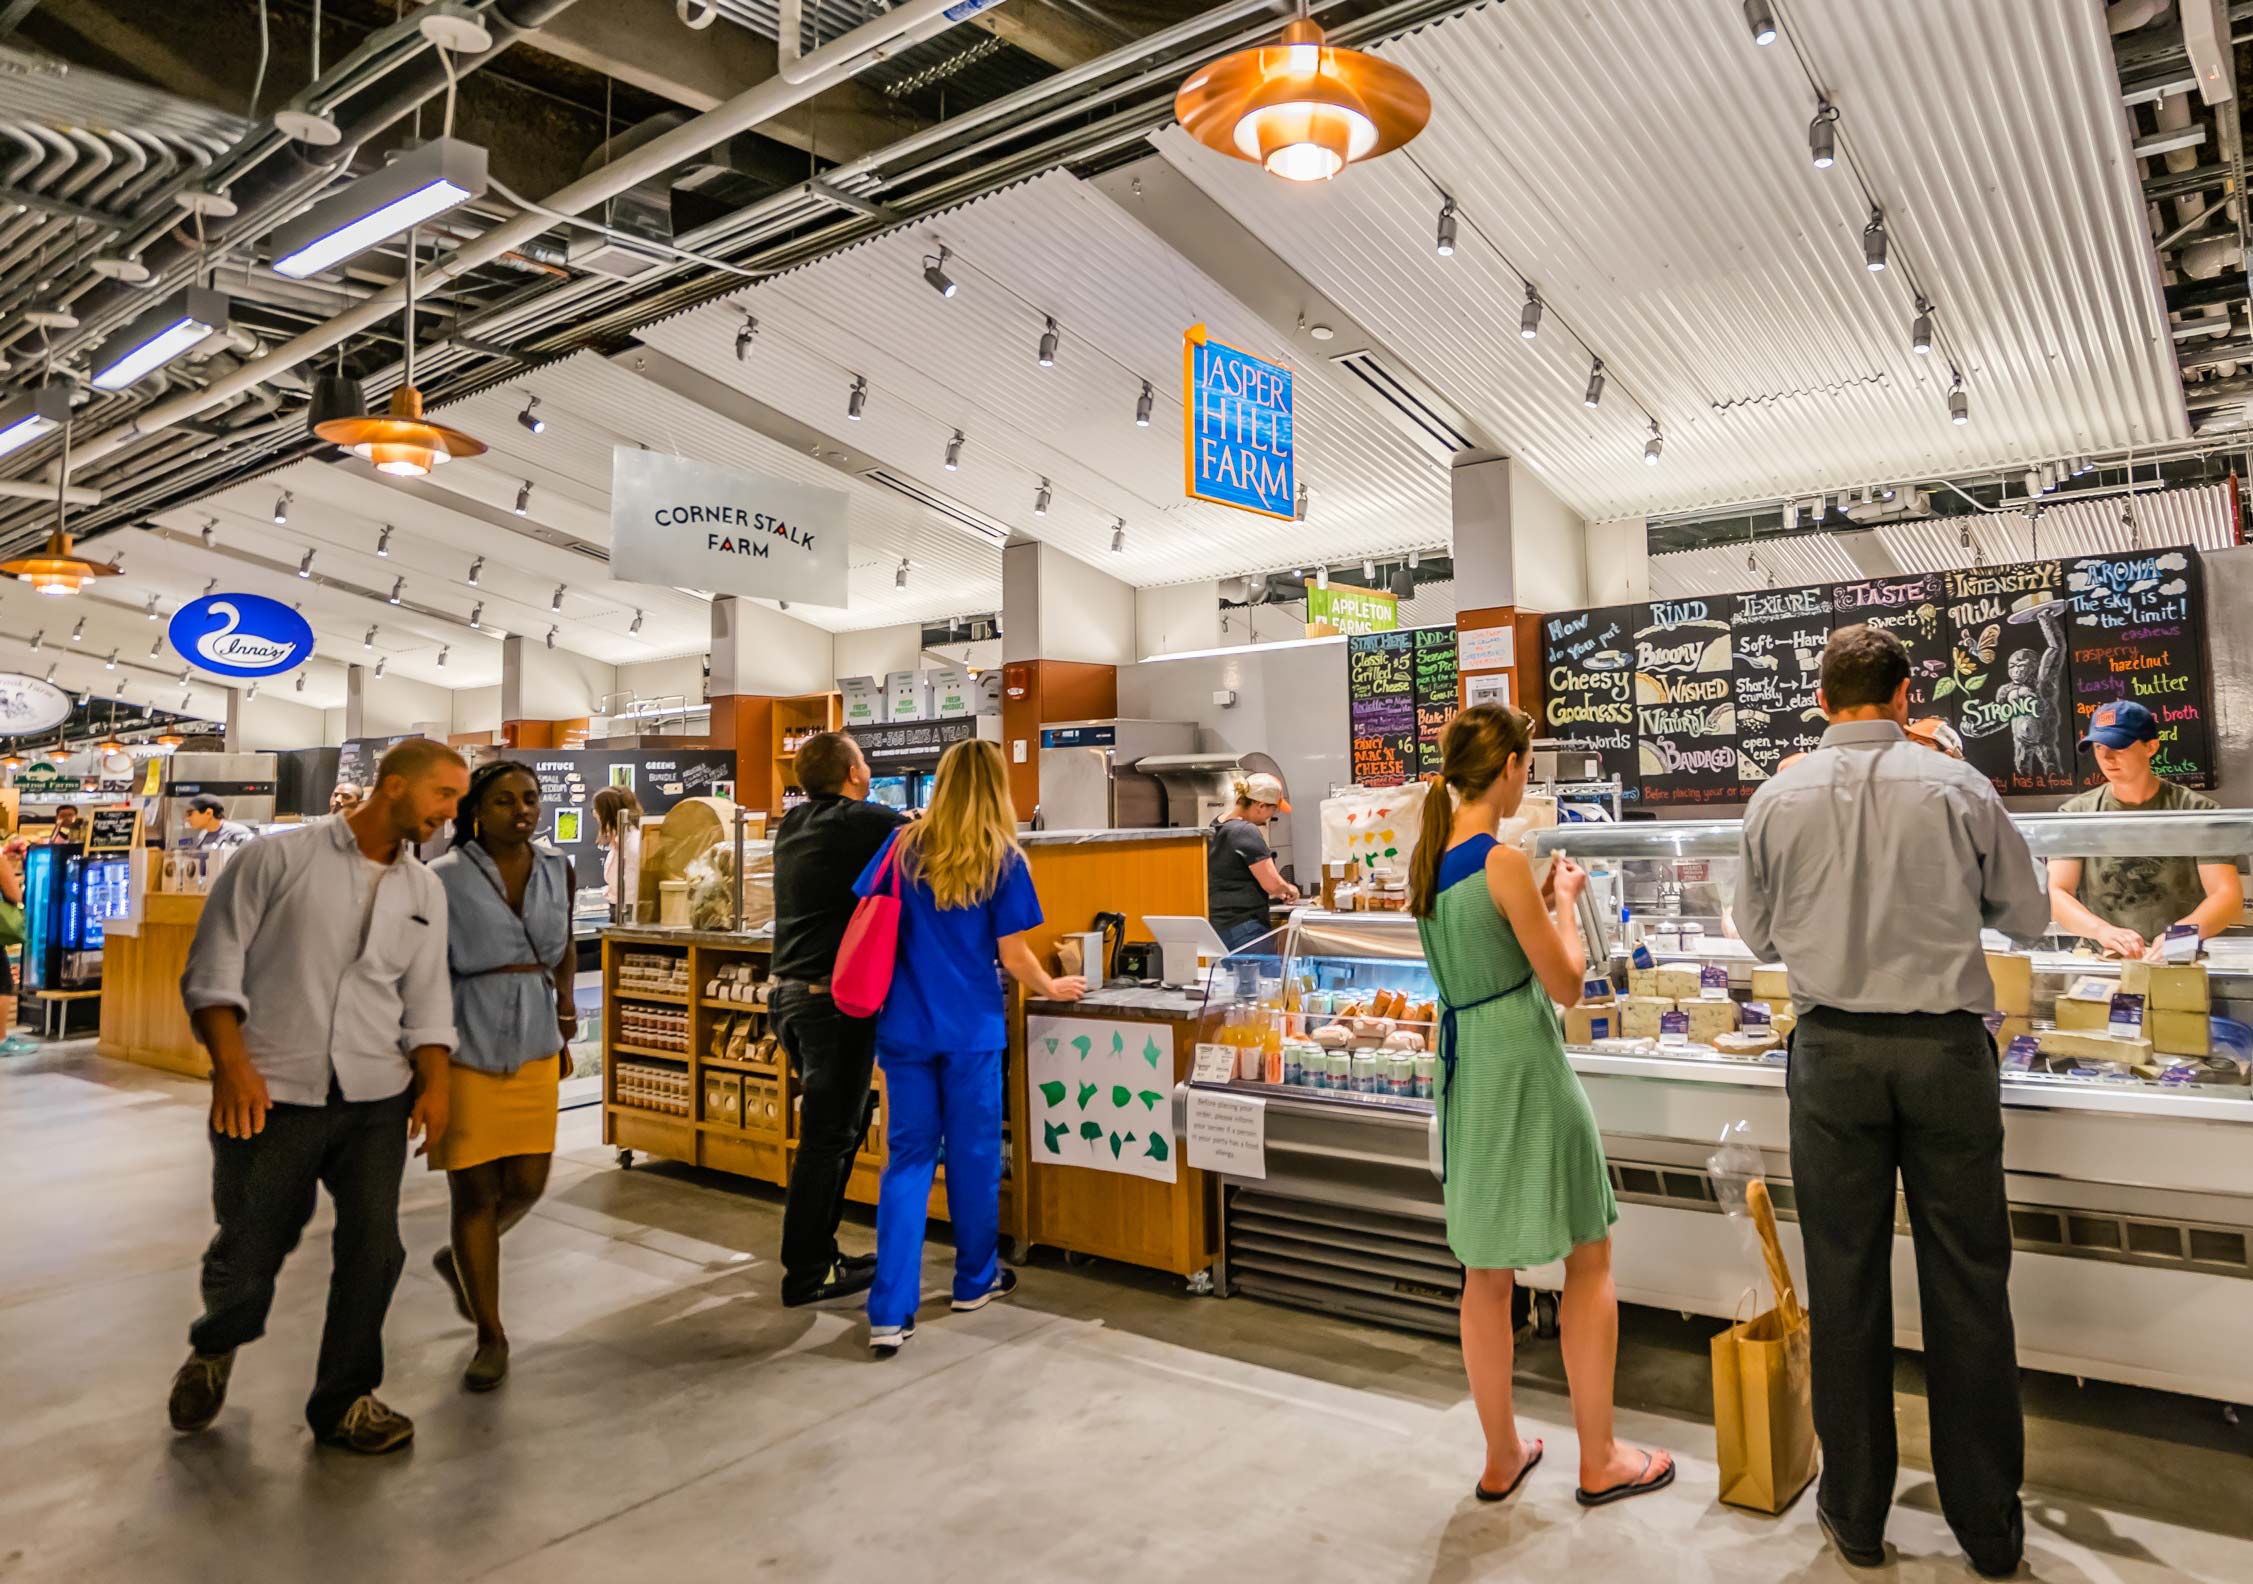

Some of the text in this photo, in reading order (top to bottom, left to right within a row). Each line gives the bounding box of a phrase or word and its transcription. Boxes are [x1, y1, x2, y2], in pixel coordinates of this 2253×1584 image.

[1202, 349, 1289, 414] JASPER
[1202, 391, 1288, 458] HILL
[1202, 437, 1289, 510] FARM
[655, 505, 815, 550] CORNER STALK
[707, 533, 769, 558] FARM
[2086, 557, 2163, 591] AROMA
[1736, 586, 1821, 617] TEXTURE
[1847, 580, 1926, 607] TASTE
[2069, 594, 2100, 612] The
[2141, 592, 2157, 605] is
[1332, 597, 1392, 622] APPLETON
[1948, 596, 2007, 629] Mild
[1332, 616, 1372, 635] FARMS
[1547, 613, 1589, 642] How
[2101, 613, 2128, 628] the
[1415, 630, 1457, 648] ADD-O
[1548, 646, 1564, 663] do
[1599, 622, 1622, 648] put
[1740, 627, 1829, 656] Soft Hard
[2121, 626, 2181, 641] cashews
[220, 638, 284, 657] Inna's
[1351, 650, 1390, 667] Classic
[2109, 650, 2171, 672] hazelnut
[1351, 664, 1391, 682] Grilled
[1373, 680, 1410, 693] Cheese
[1550, 666, 1631, 702] Cheesy
[2077, 673, 2189, 696] toasty butter
[1546, 692, 1633, 727] Goodness
[1790, 692, 1818, 708] elast
[2163, 705, 2200, 722] broth
[1354, 737, 1384, 750] FANCY
[1742, 733, 1821, 754] open close
[536, 761, 676, 771] LETTUCE GREENS
[1753, 748, 1781, 767] eyes
[1355, 760, 1404, 776] CHEESE
[542, 784, 568, 793] EDIUM
[2012, 772, 2034, 788] has
[2036, 776, 2047, 787] a
[2047, 773, 2073, 788] food
[543, 794, 563, 802] ARGE
[1644, 786, 1669, 800] Before
[1672, 785, 1701, 802] placing
[1703, 788, 1724, 802] your
